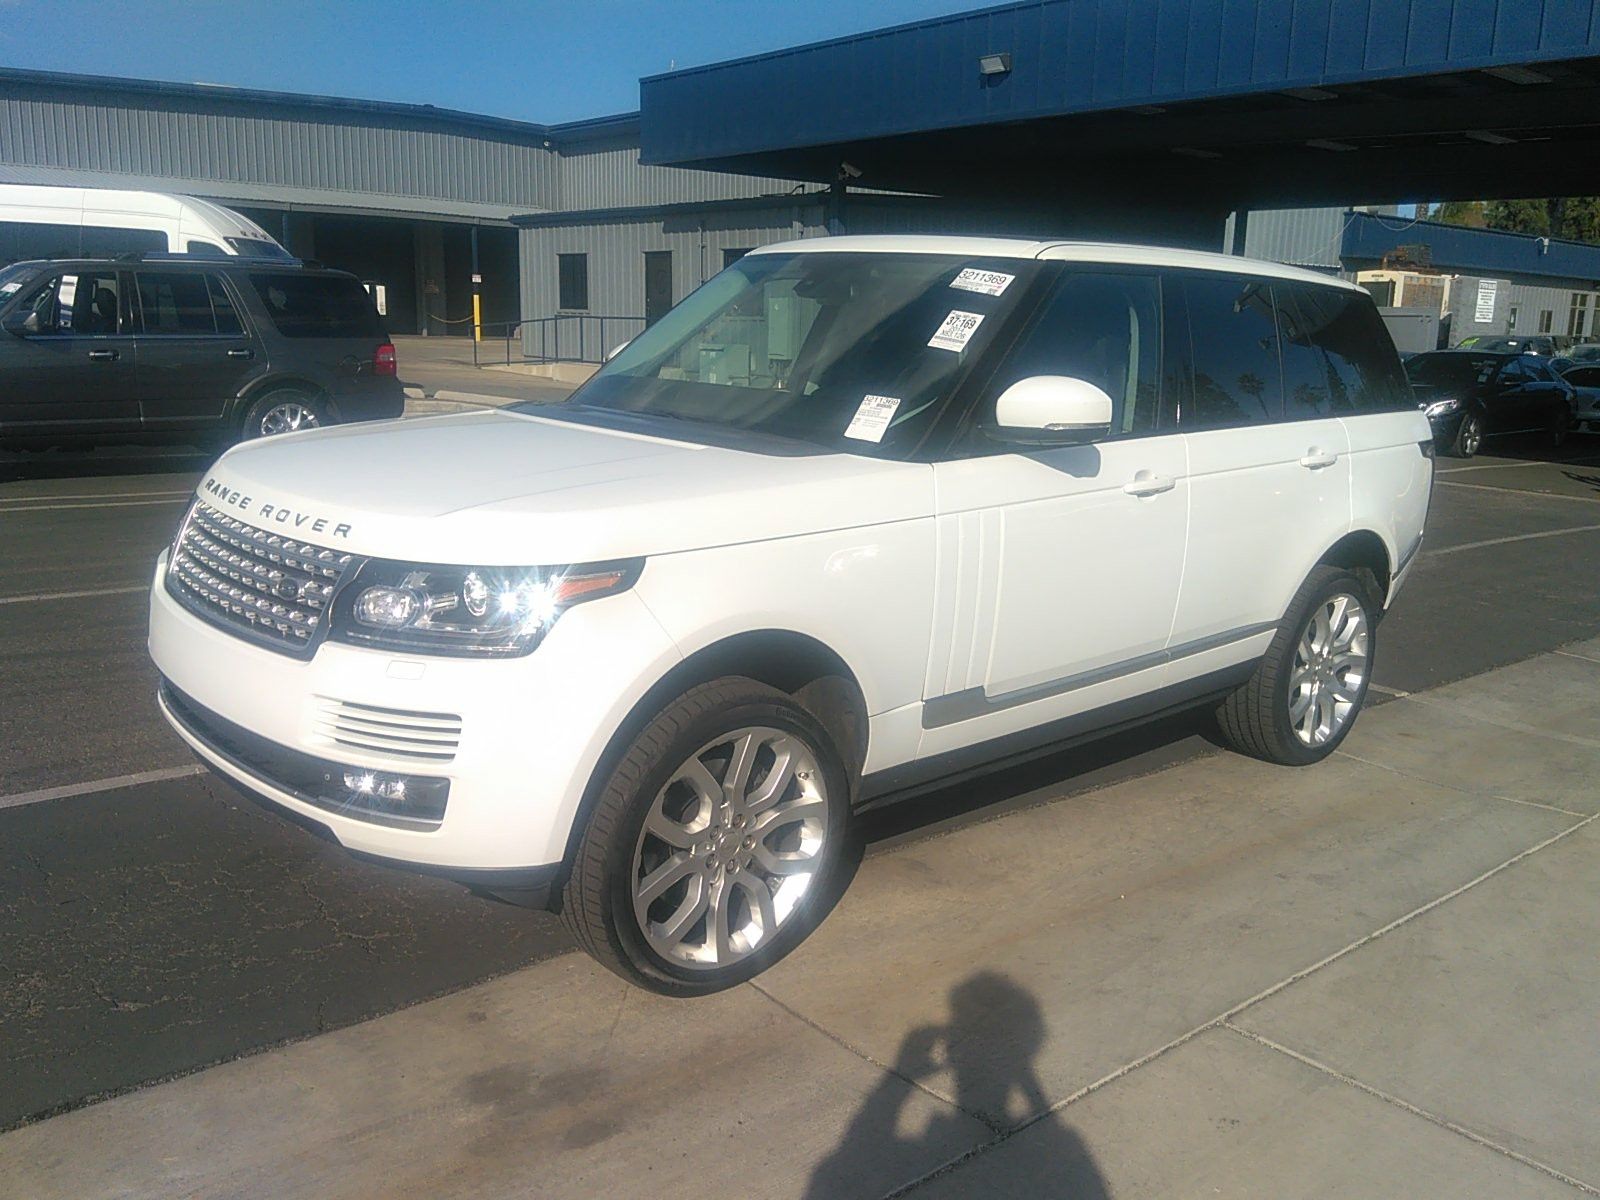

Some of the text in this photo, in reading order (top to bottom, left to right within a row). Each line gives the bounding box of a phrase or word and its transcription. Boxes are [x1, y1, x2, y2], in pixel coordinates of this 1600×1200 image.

[959, 270, 1007, 285] 3211369
[204, 478, 353, 538] RANGE ROVER
